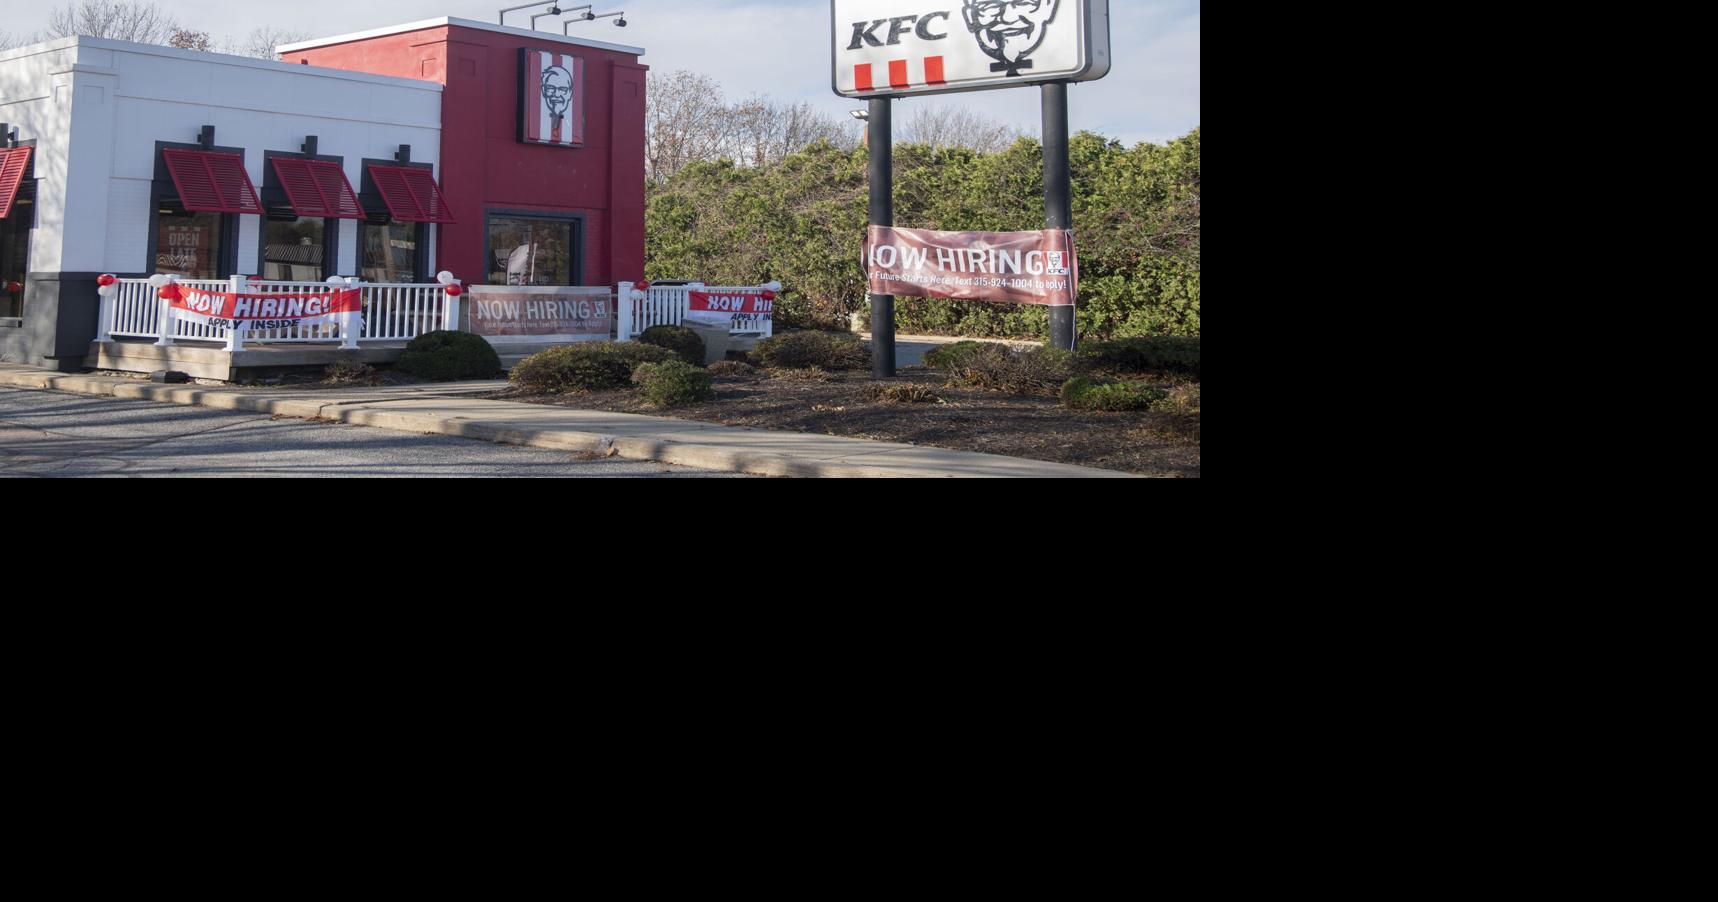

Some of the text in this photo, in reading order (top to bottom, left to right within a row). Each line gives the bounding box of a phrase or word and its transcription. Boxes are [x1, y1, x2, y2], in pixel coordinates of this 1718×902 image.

[847, 11, 950, 50] KFC
[169, 232, 200, 246] OPEN
[936, 247, 1044, 275] HIRING
[875, 271, 900, 281] Future
[974, 277, 1033, 289] 315-924-1004
[186, 291, 330, 318] NOW HIRING!
[477, 300, 590, 320] NOW HIRING
[707, 295, 745, 311] NOW
[208, 317, 301, 330] APPLY INSIDE
[730, 313, 759, 321] APPLY
